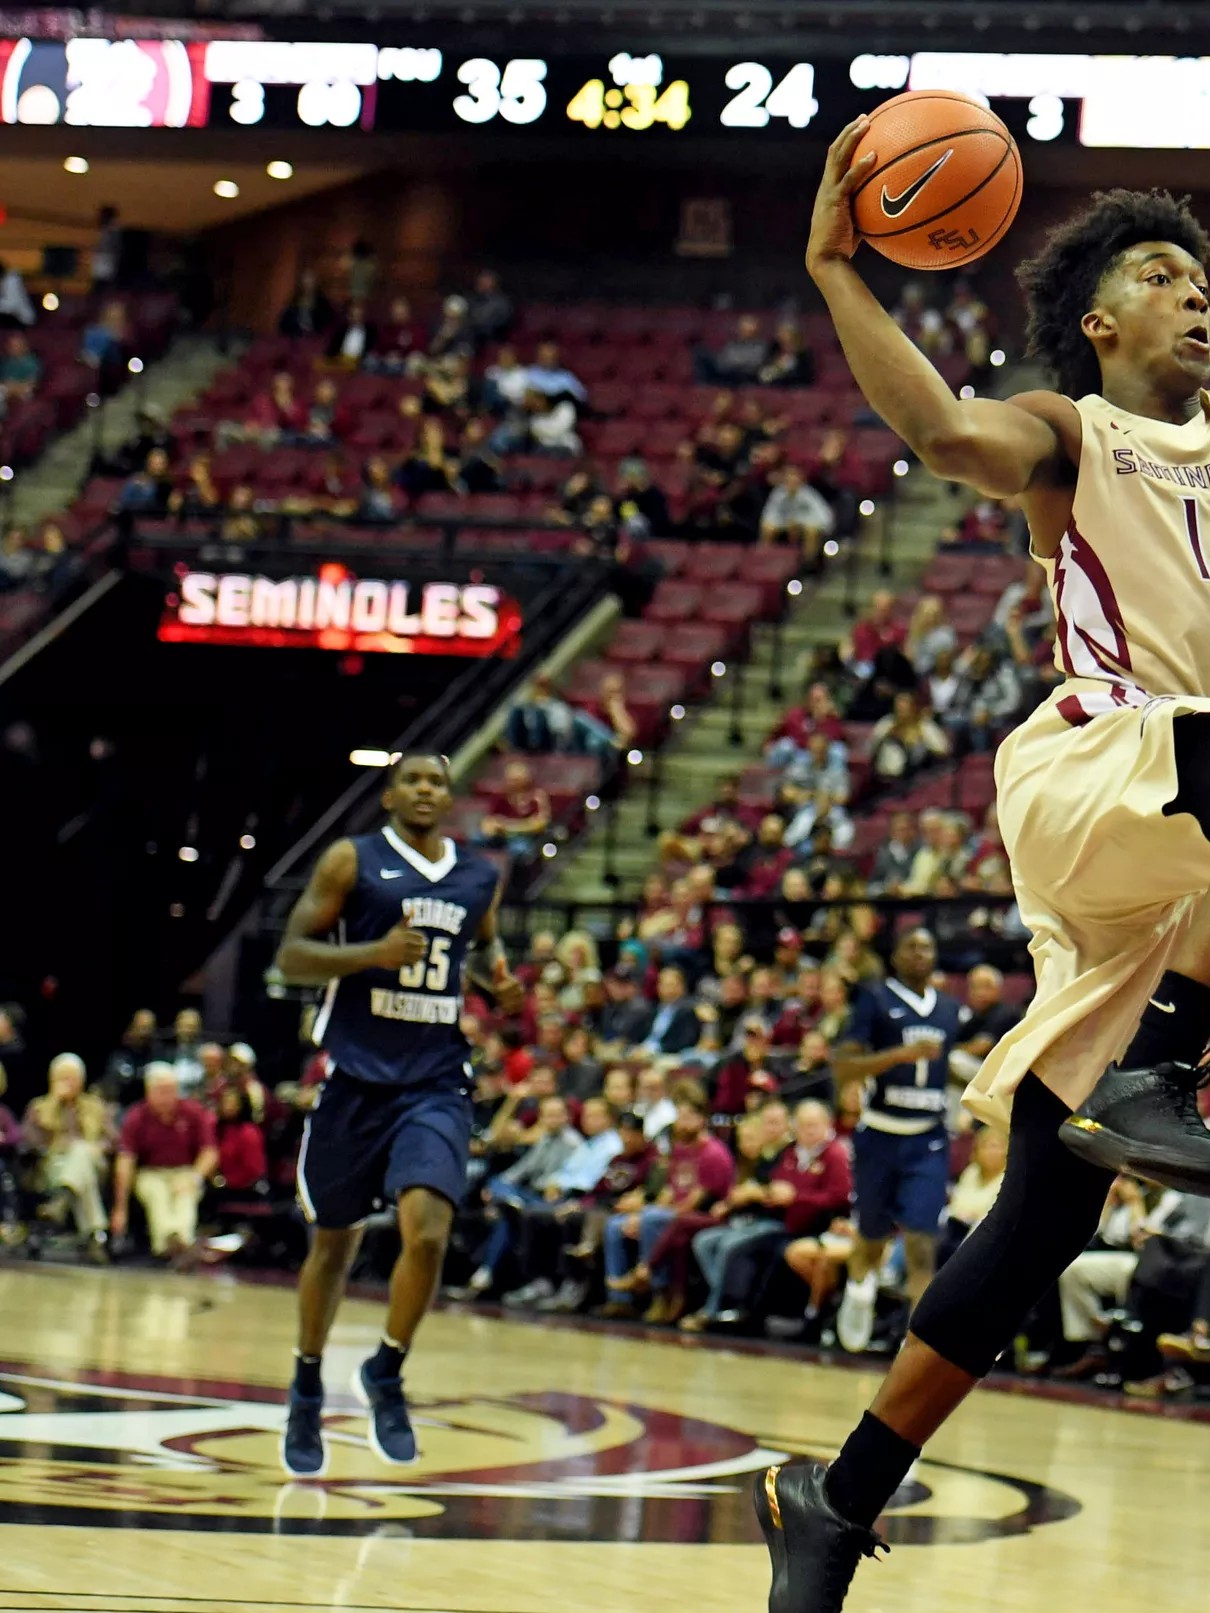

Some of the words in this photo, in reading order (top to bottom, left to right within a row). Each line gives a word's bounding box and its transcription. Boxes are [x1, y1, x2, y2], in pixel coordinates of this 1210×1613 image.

[453, 58, 547, 124] 35
[566, 79, 692, 130] 4:34
[720, 62, 819, 128] 24
[927, 227, 982, 251] FSU
[178, 571, 500, 639] SEMINOLES
